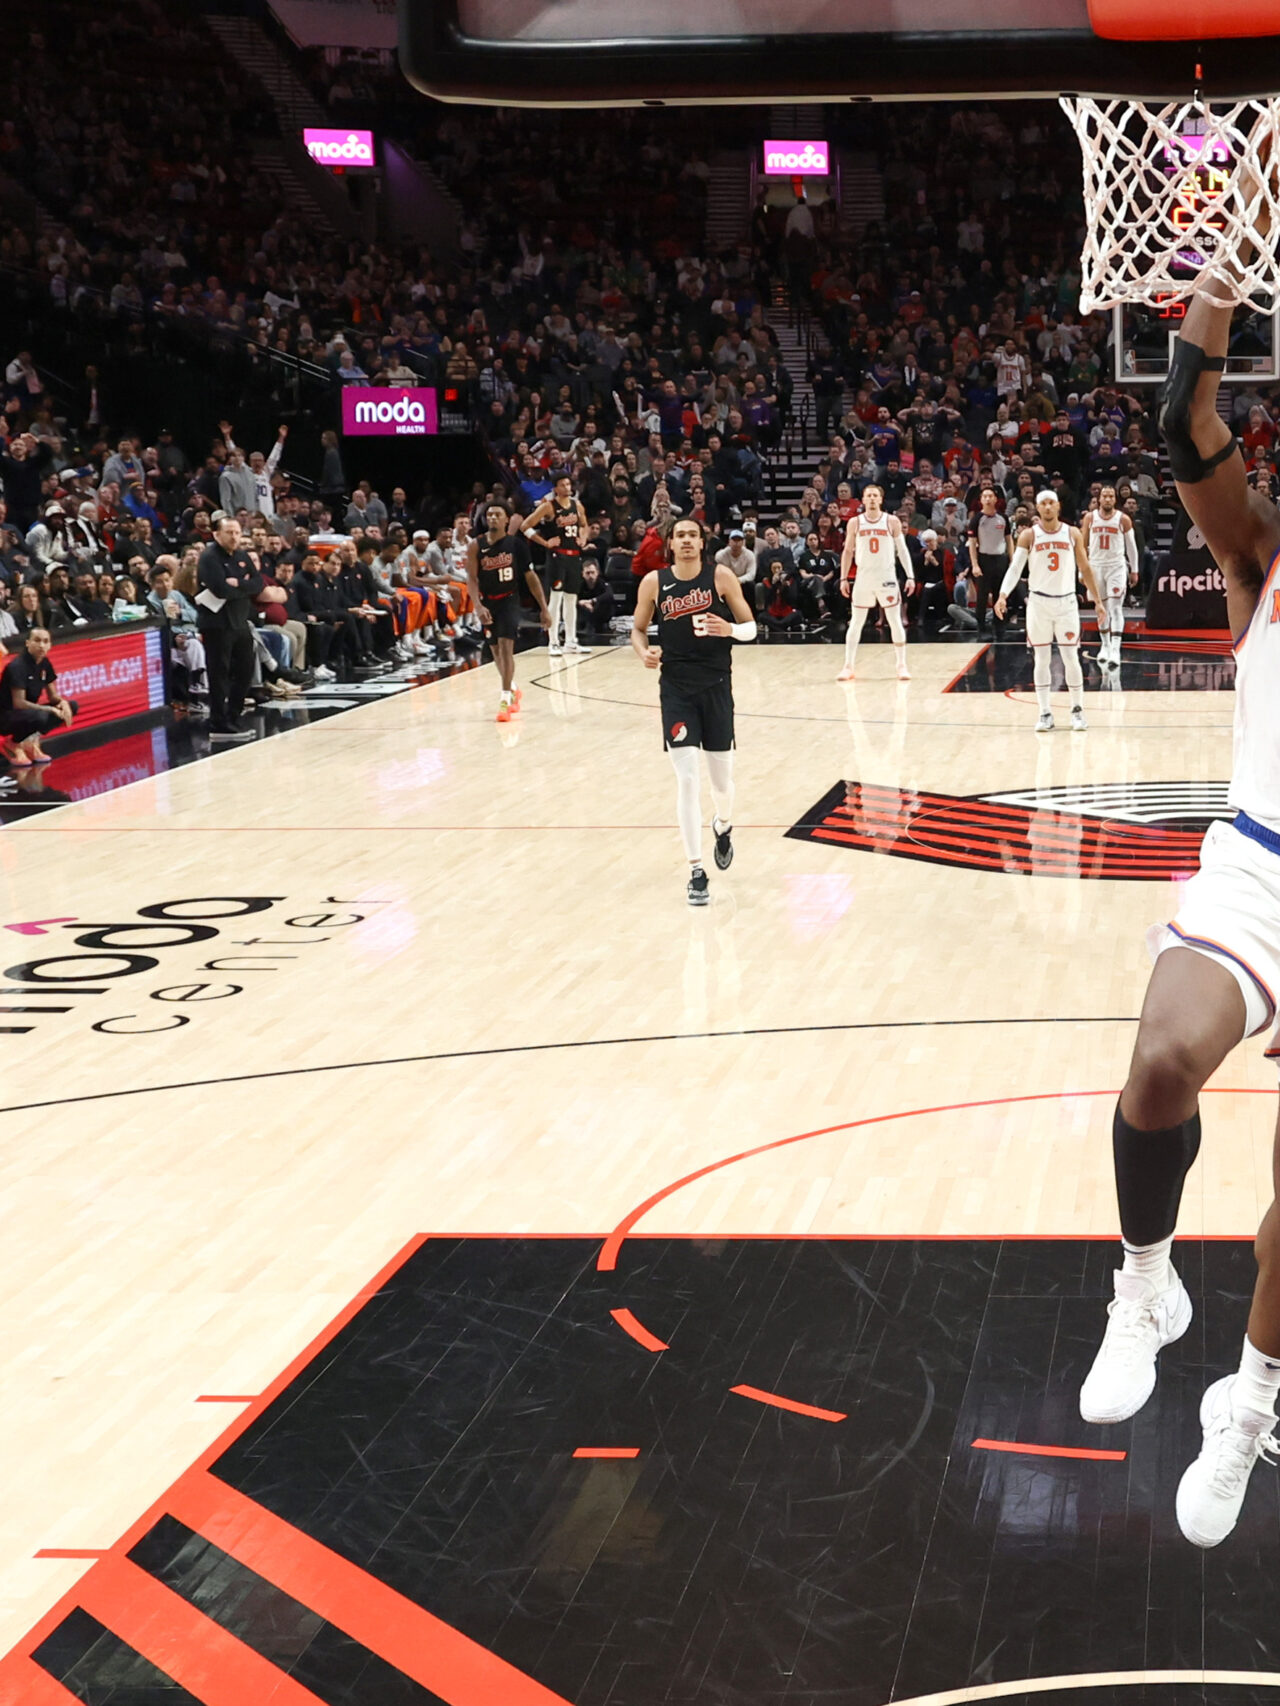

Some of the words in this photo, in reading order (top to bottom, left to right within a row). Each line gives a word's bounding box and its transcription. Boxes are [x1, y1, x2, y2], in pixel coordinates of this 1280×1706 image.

[307, 134, 371, 159] moda
[767, 145, 827, 169] moda
[355, 396, 425, 423] moda
[395, 425, 426, 434] HEALTH
[564, 525, 578, 538] 33
[869, 537, 880, 554] 0
[1034, 542, 1051, 552] NEW
[1052, 541, 1070, 551] YORK
[1099, 535, 1110, 550] 11
[1047, 552, 1060, 572] 3
[498, 566, 514, 582] 19
[661, 587, 713, 616] ripcity
[692, 613, 709, 637] 5
[91, 896, 392, 1034] center
